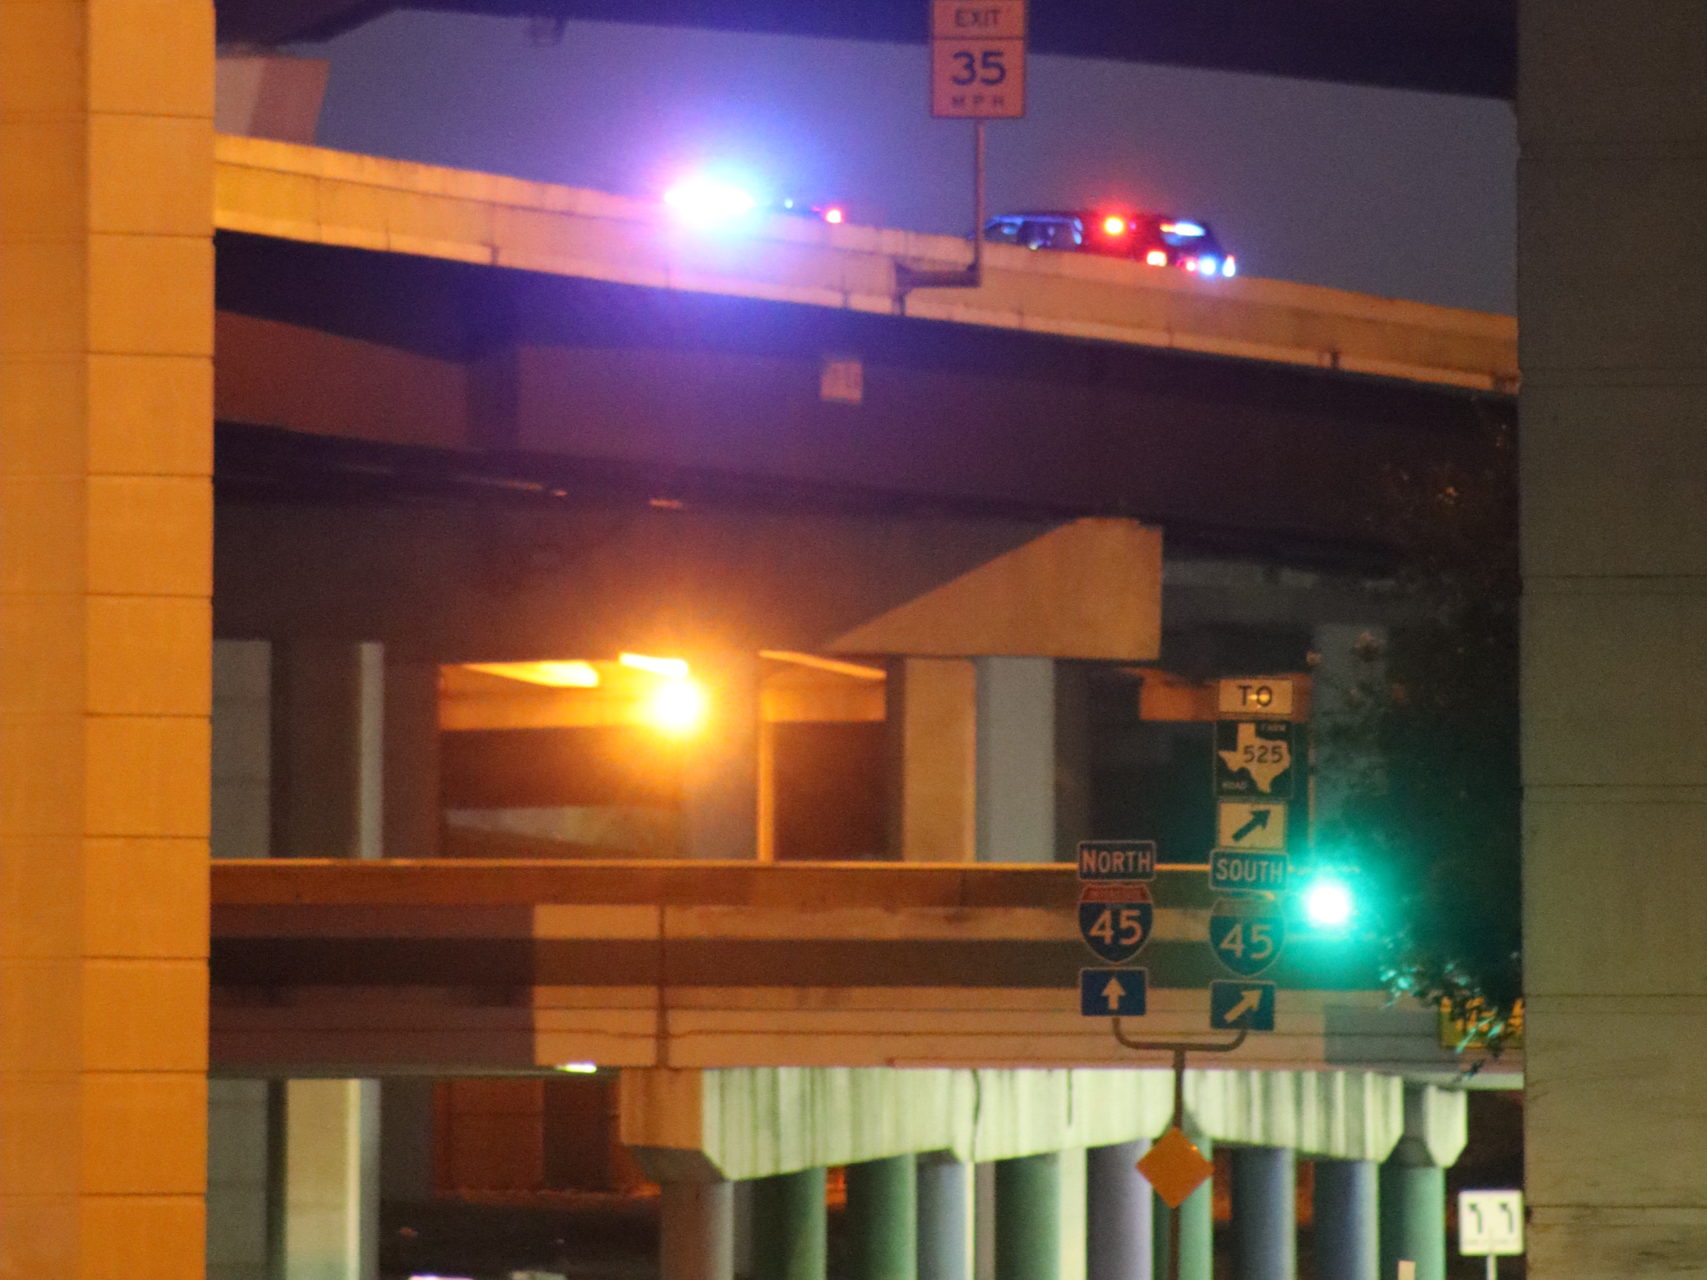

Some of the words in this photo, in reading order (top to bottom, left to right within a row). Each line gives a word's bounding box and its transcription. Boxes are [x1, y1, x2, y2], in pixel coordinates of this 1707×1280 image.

[954, 9, 1001, 27] EXIT
[952, 51, 1006, 86] 35
[1238, 685, 1272, 707] TO
[1243, 745, 1284, 764] 525
[1082, 849, 1151, 873] NORTH
[1216, 858, 1283, 883] SOUTH
[1089, 909, 1143, 945] 45
[1220, 923, 1273, 959] 45
